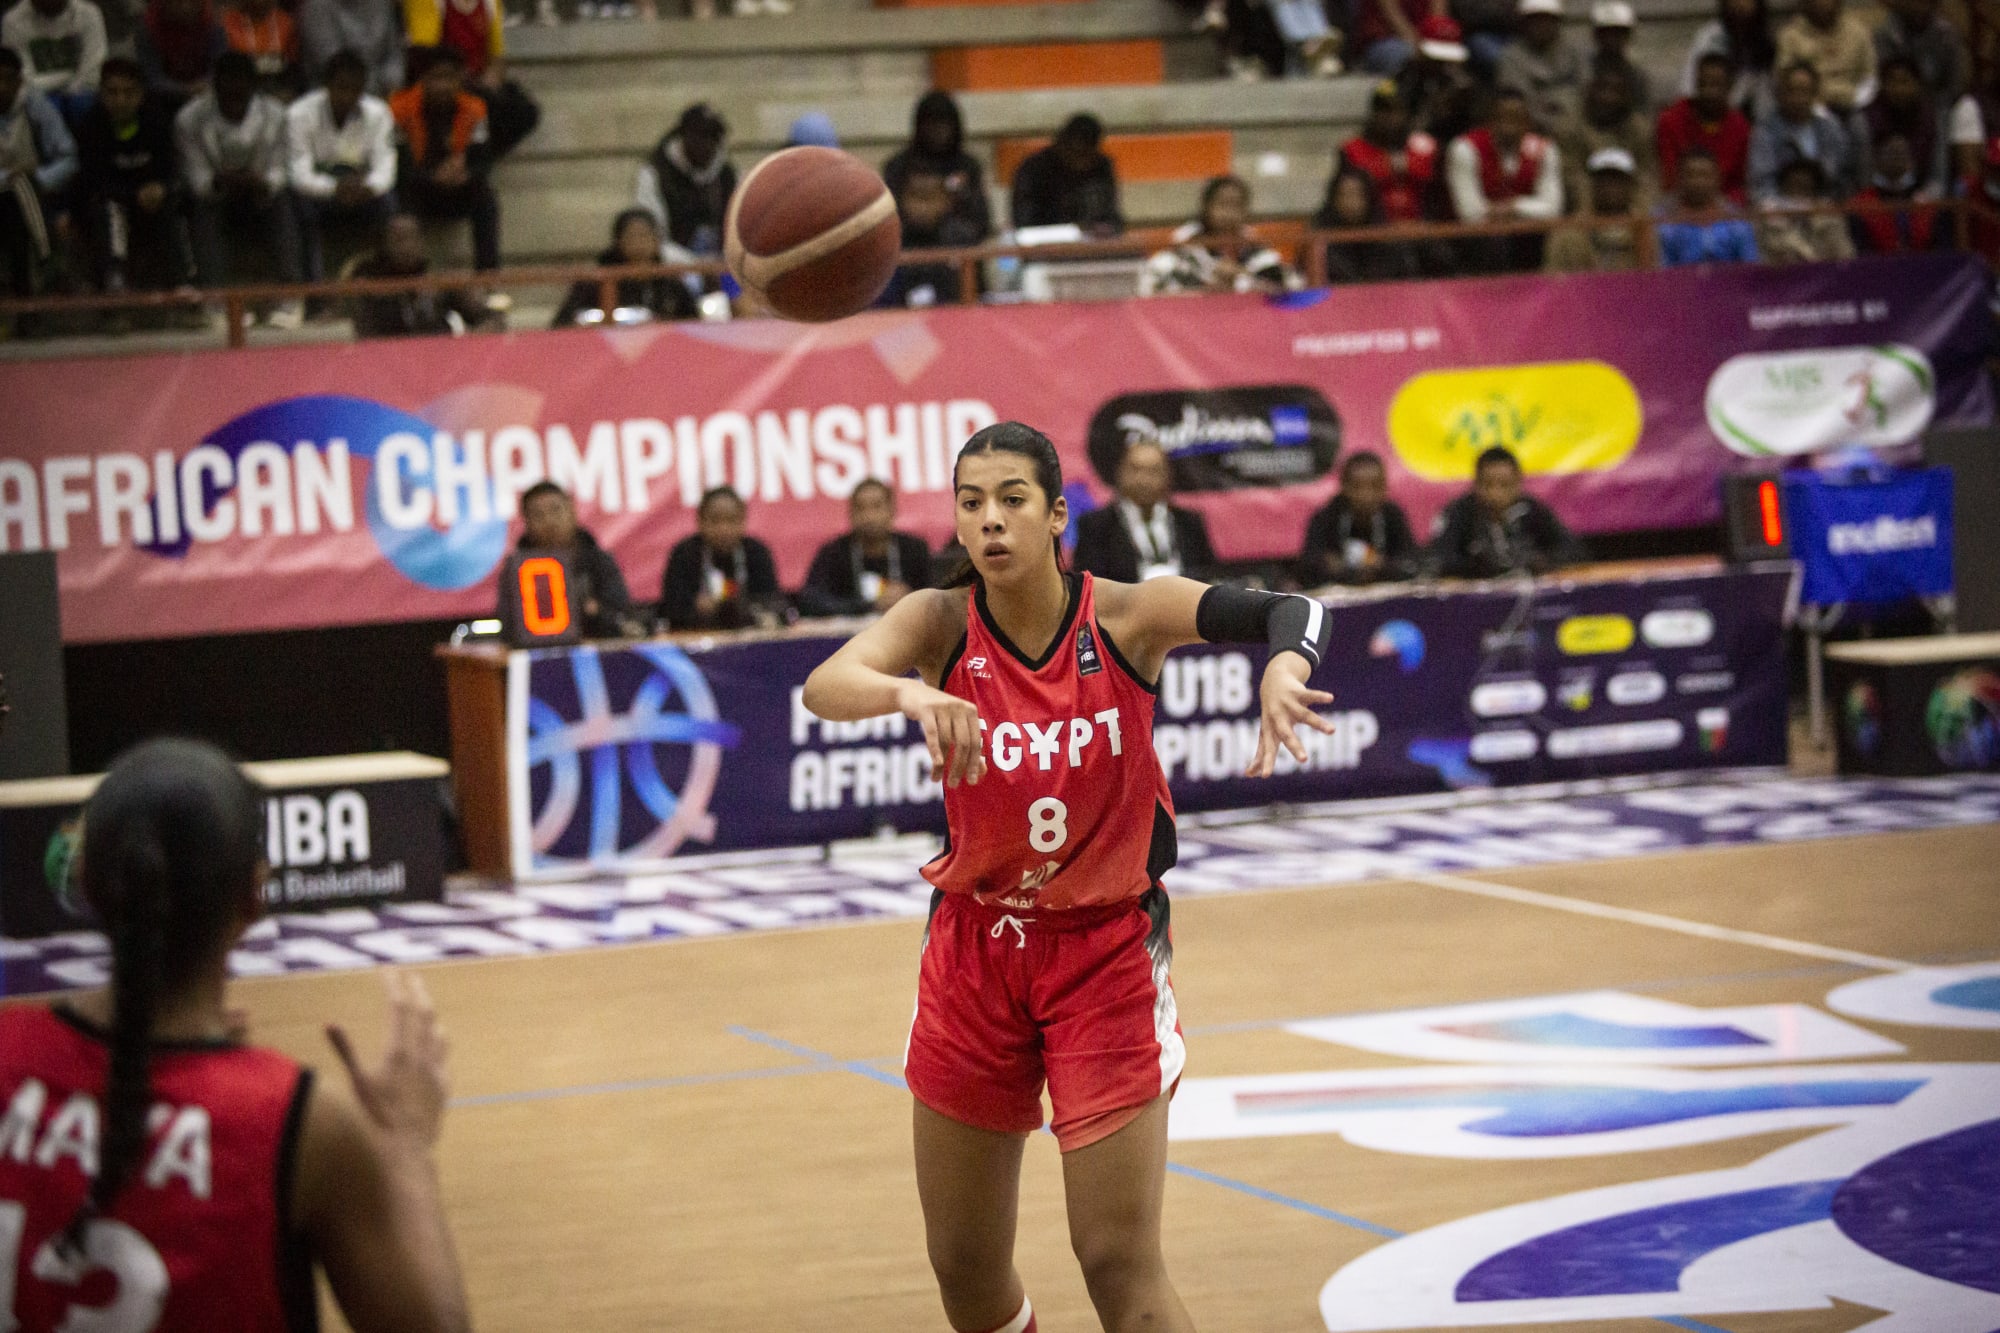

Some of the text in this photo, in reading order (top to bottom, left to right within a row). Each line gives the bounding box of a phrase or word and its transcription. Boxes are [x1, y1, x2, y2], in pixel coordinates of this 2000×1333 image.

[0, 399, 998, 552] AFRICAN CHAMPIONSHIP
[1759, 480, 1783, 546] 1
[518, 557, 570, 636] 0
[1162, 652, 1253, 718] U18
[790, 743, 944, 812] AFRIC
[263, 789, 370, 869] IBA
[1028, 797, 1067, 853] 8
